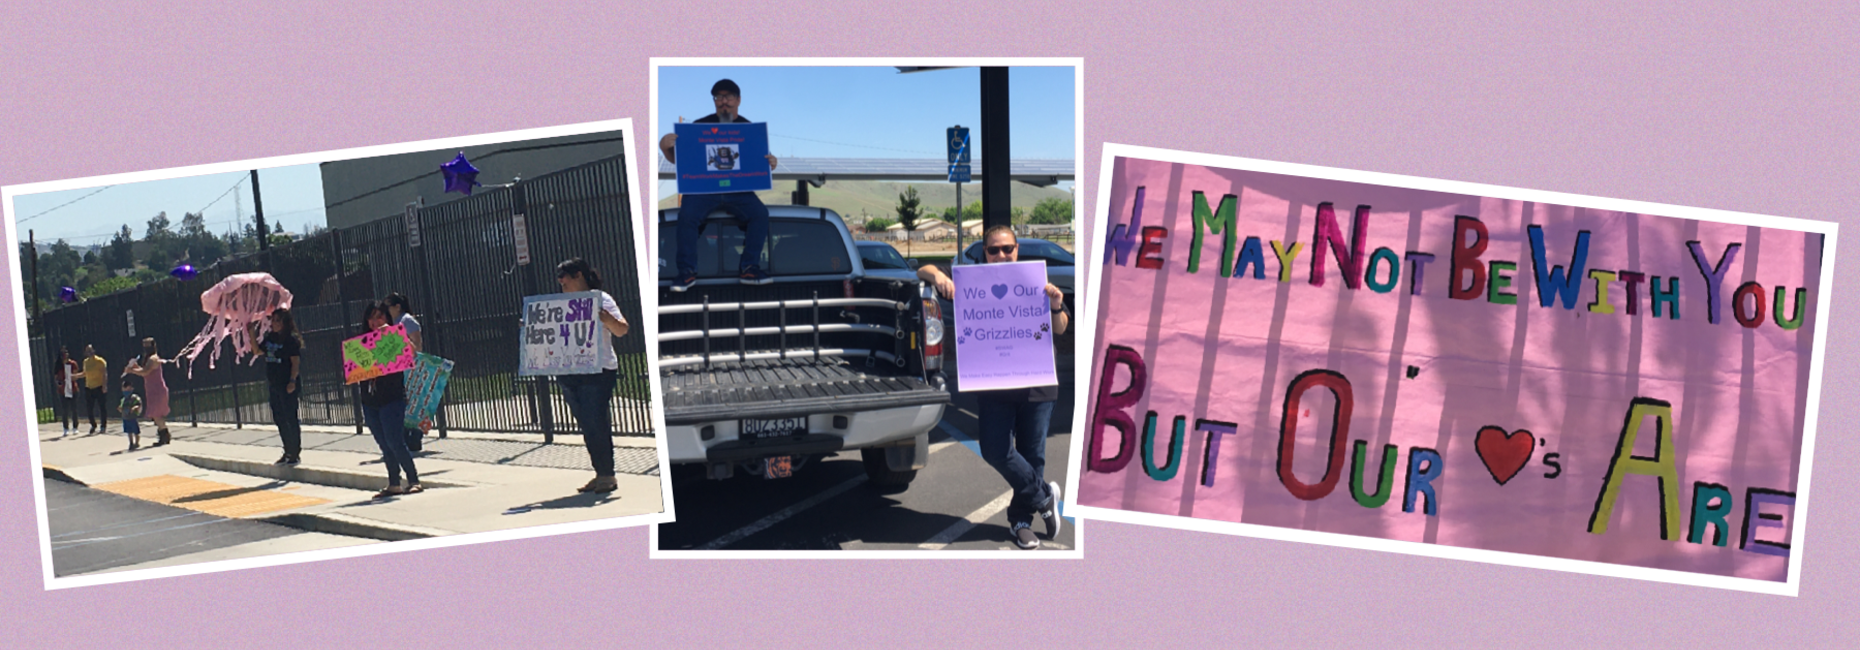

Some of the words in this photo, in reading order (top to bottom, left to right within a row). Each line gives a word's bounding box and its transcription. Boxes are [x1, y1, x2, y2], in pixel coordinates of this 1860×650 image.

[1187, 190, 1305, 282] MAY
[1308, 202, 1435, 295] NOT
[1448, 215, 1518, 305] BE
[1527, 224, 1681, 320] WITH
[1685, 240, 1807, 330] YOU
[963, 286, 986, 300] We
[1013, 284, 1038, 297] Our
[527, 302, 563, 325] We're
[963, 307, 1004, 320] Monte
[1008, 305, 1042, 318] Vista
[525, 325, 555, 345] Here
[560, 323, 570, 346] 4
[974, 326, 1032, 341] Grizzlies
[1086, 343, 1238, 487] BUT
[1587, 396, 1796, 557] ARE
